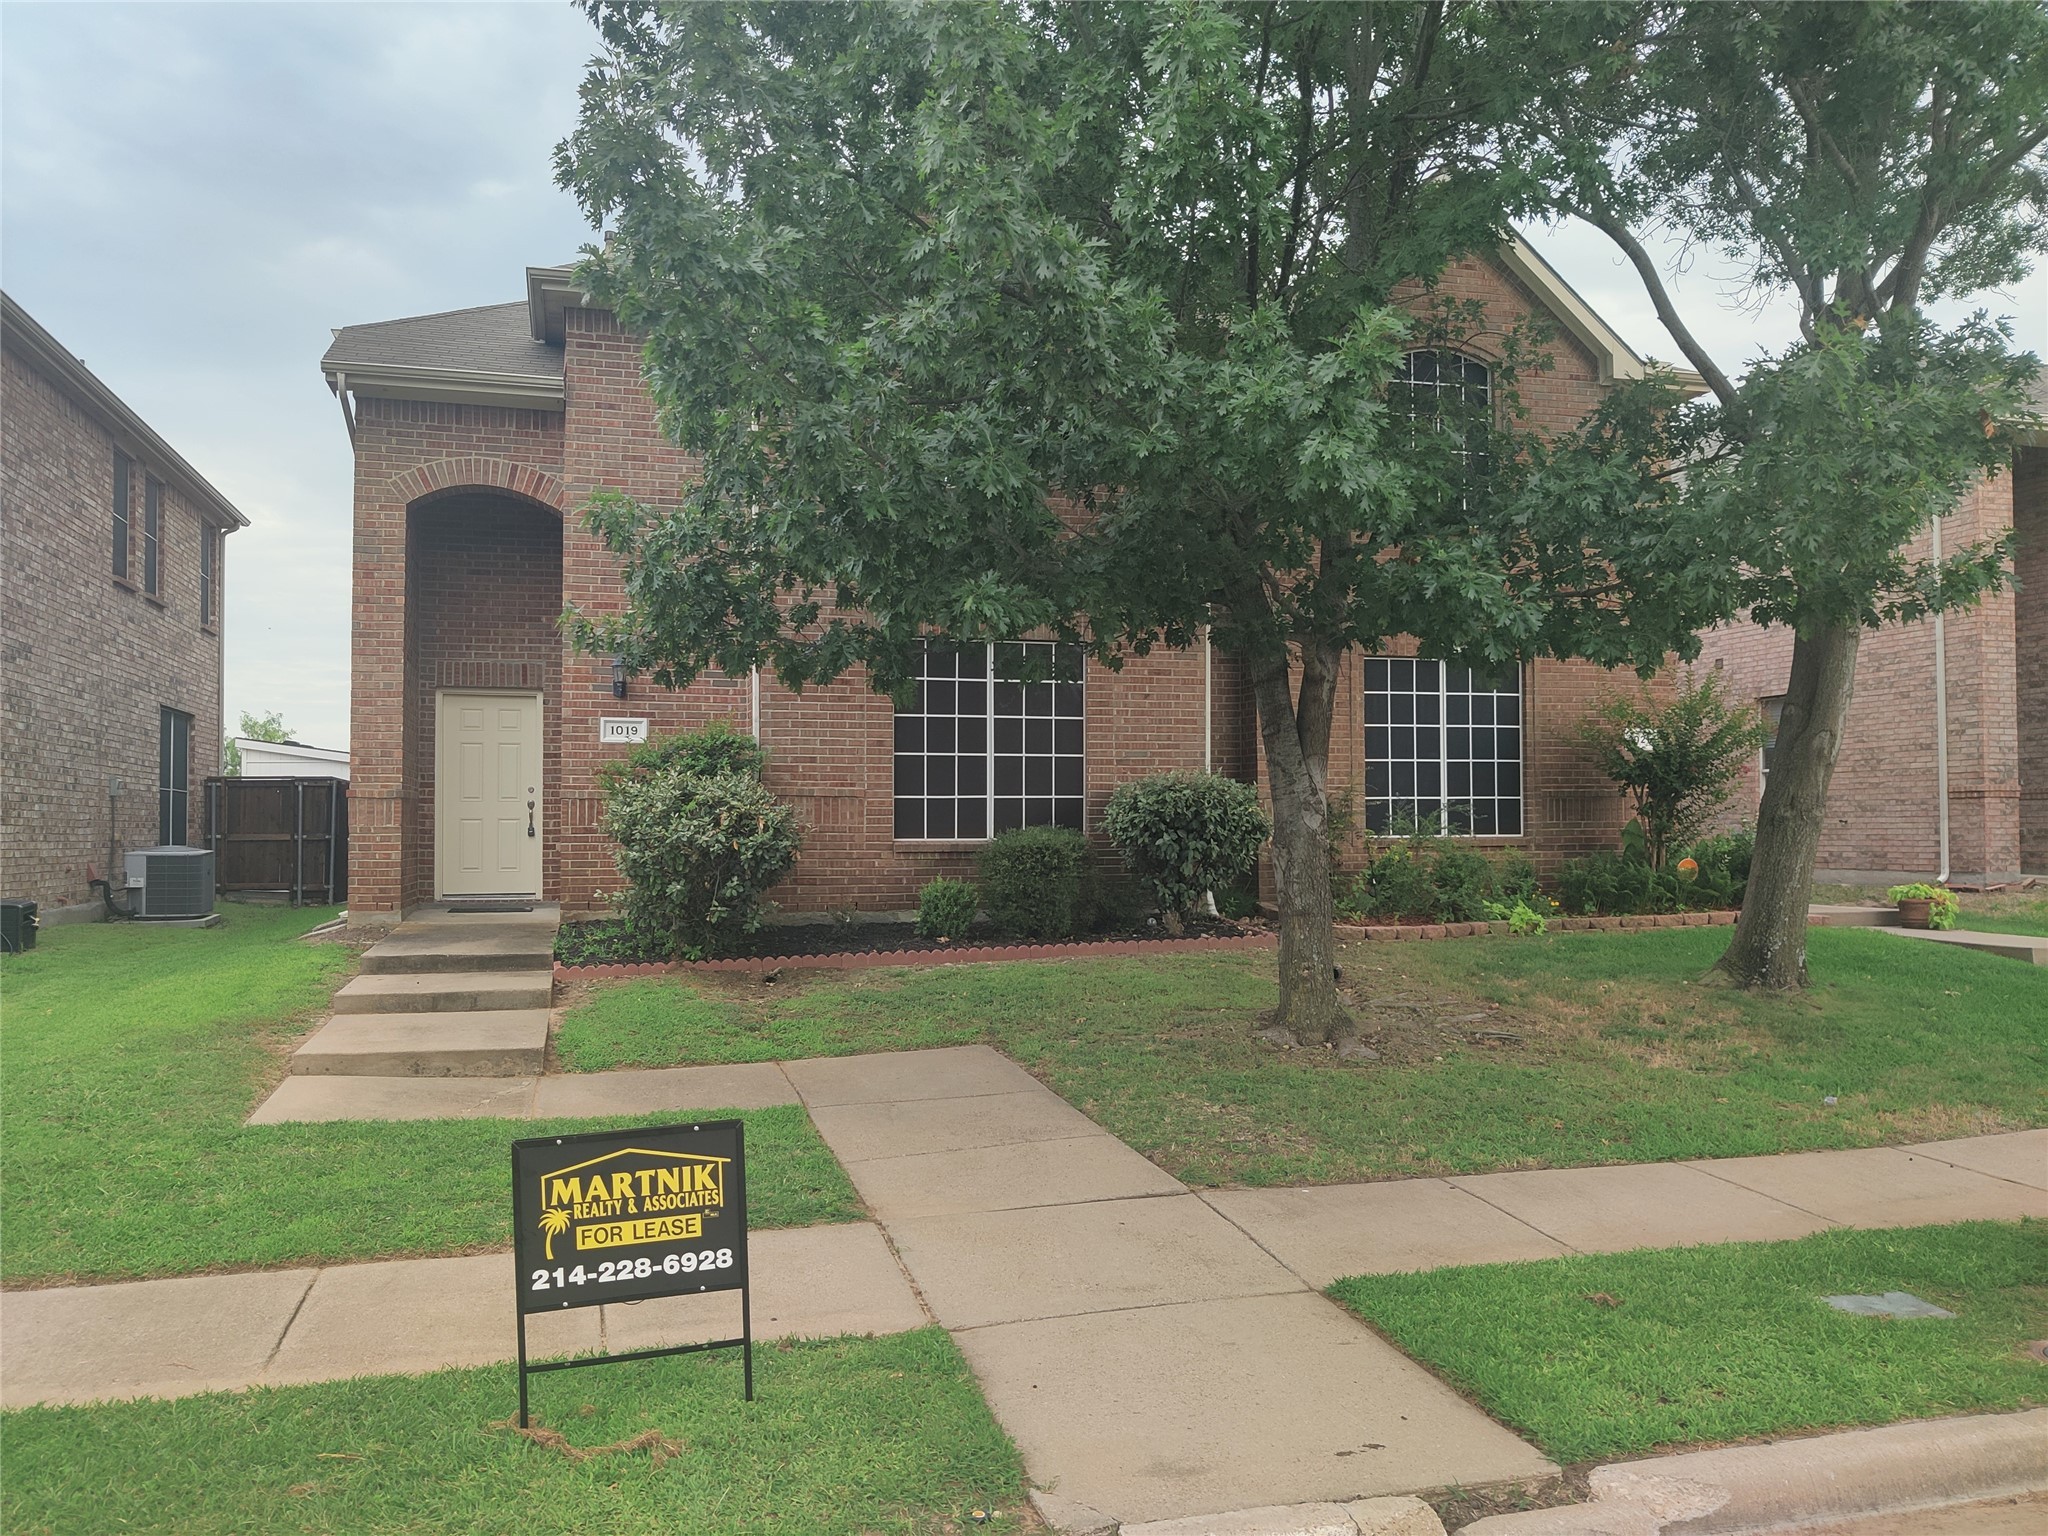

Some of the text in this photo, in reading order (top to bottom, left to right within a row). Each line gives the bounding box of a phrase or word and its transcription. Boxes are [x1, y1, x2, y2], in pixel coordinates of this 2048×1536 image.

[610, 725, 638, 735] 1019
[551, 1164, 717, 1206] MARTNIK
[573, 1189, 720, 1220] REALTY & ASSOCIATES
[581, 1217, 697, 1246] FOR LEASE
[531, 1248, 733, 1291] 214-228-6928
